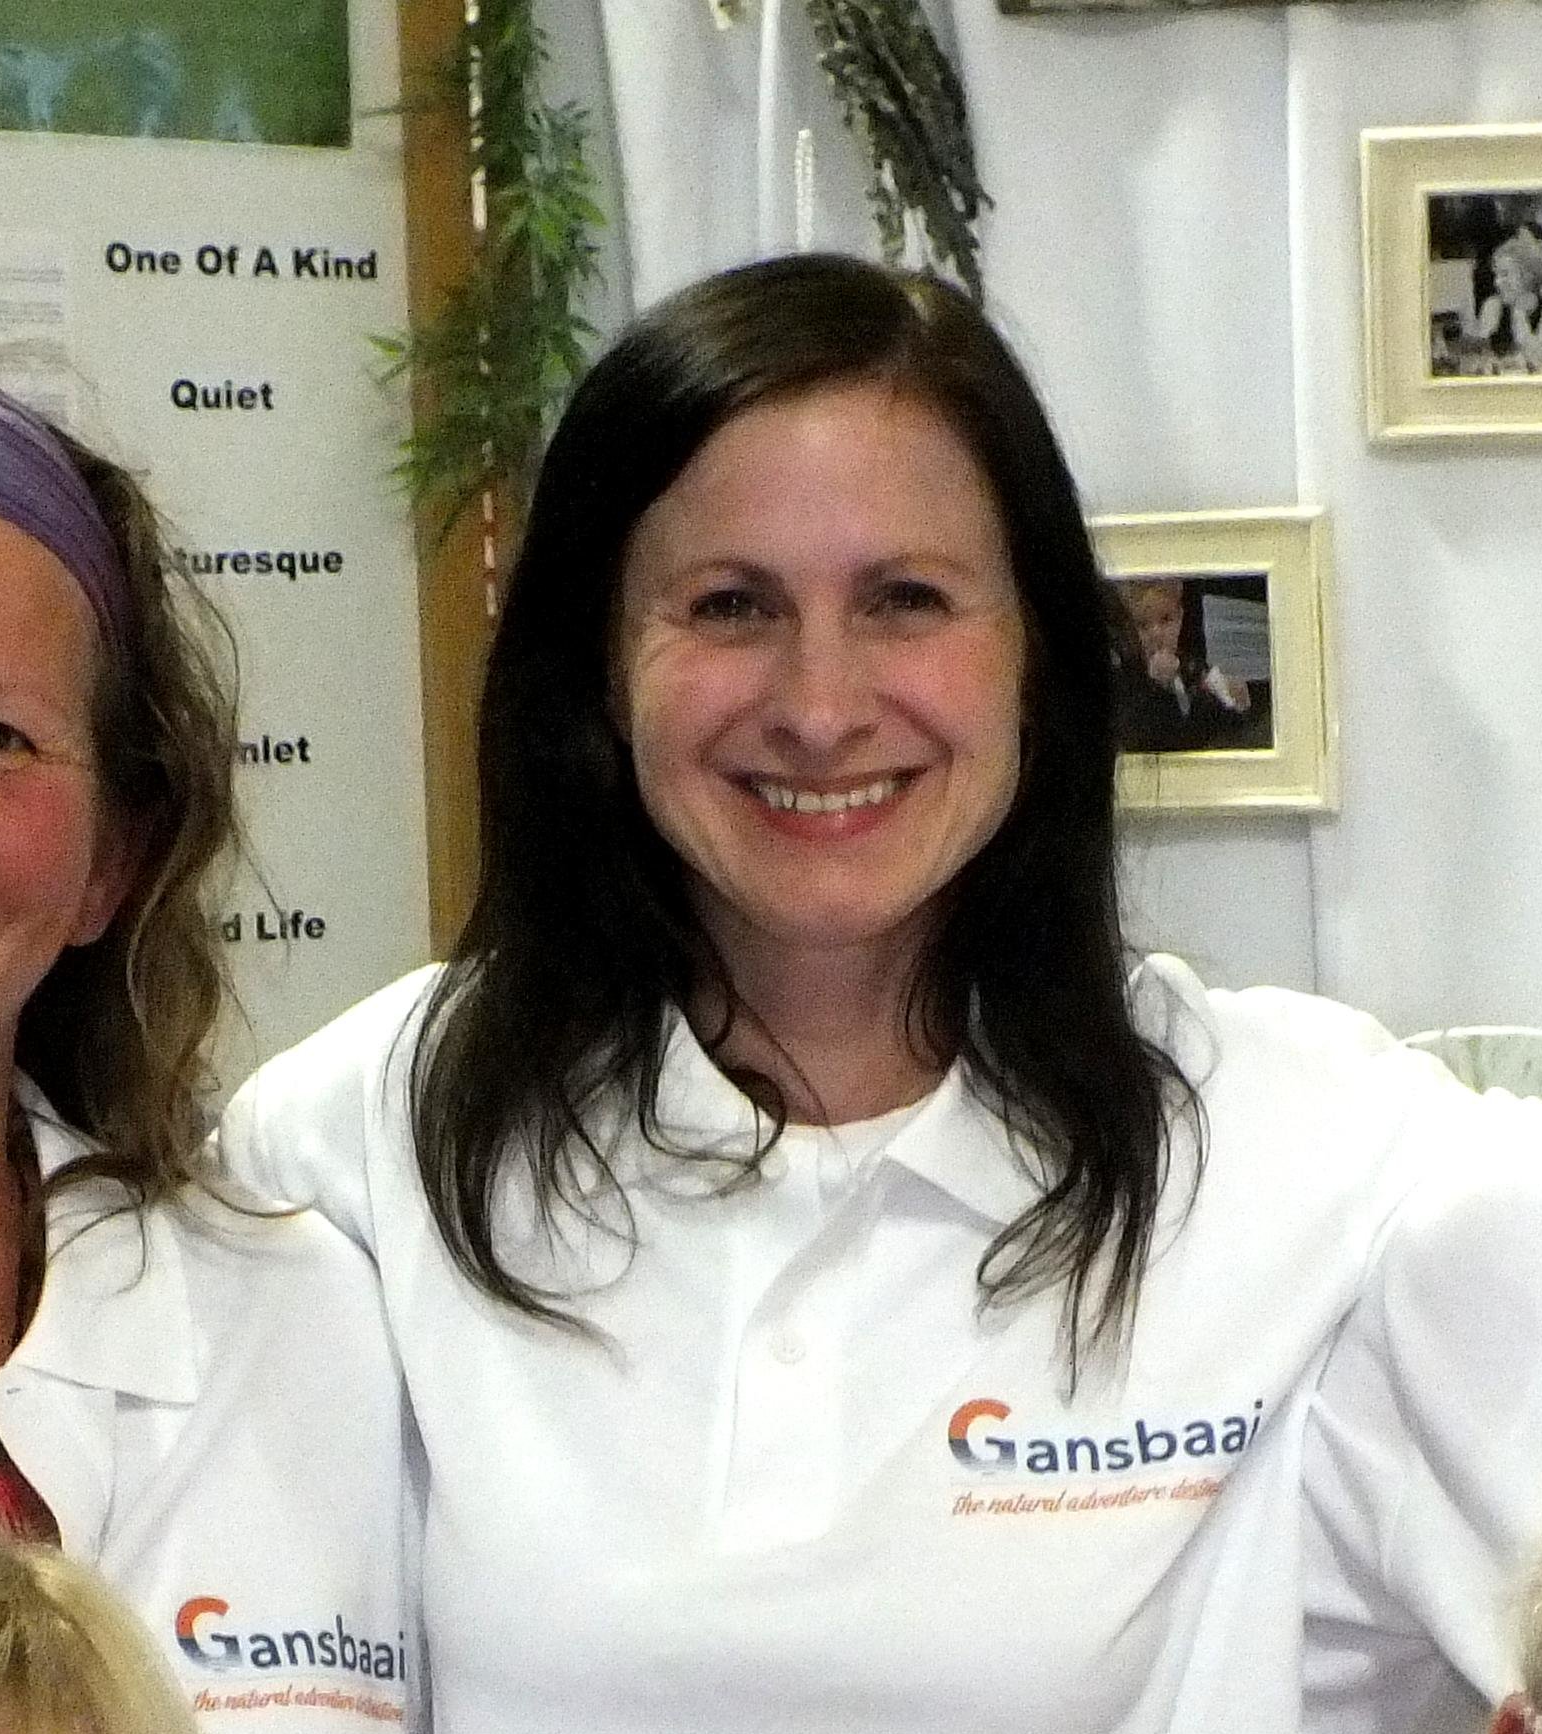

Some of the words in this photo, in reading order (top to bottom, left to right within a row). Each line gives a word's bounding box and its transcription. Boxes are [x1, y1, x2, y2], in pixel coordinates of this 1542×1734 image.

[106, 242, 182, 275] One
[196, 244, 239, 276] Of
[253, 246, 279, 278] A
[293, 247, 377, 280] Kind
[170, 378, 274, 411] Quiet
[257, 909, 326, 940] Life
[948, 1397, 1263, 1475] Gansbaai
[987, 1488, 1067, 1514] natural
[175, 1595, 406, 1681] Gansbaai
